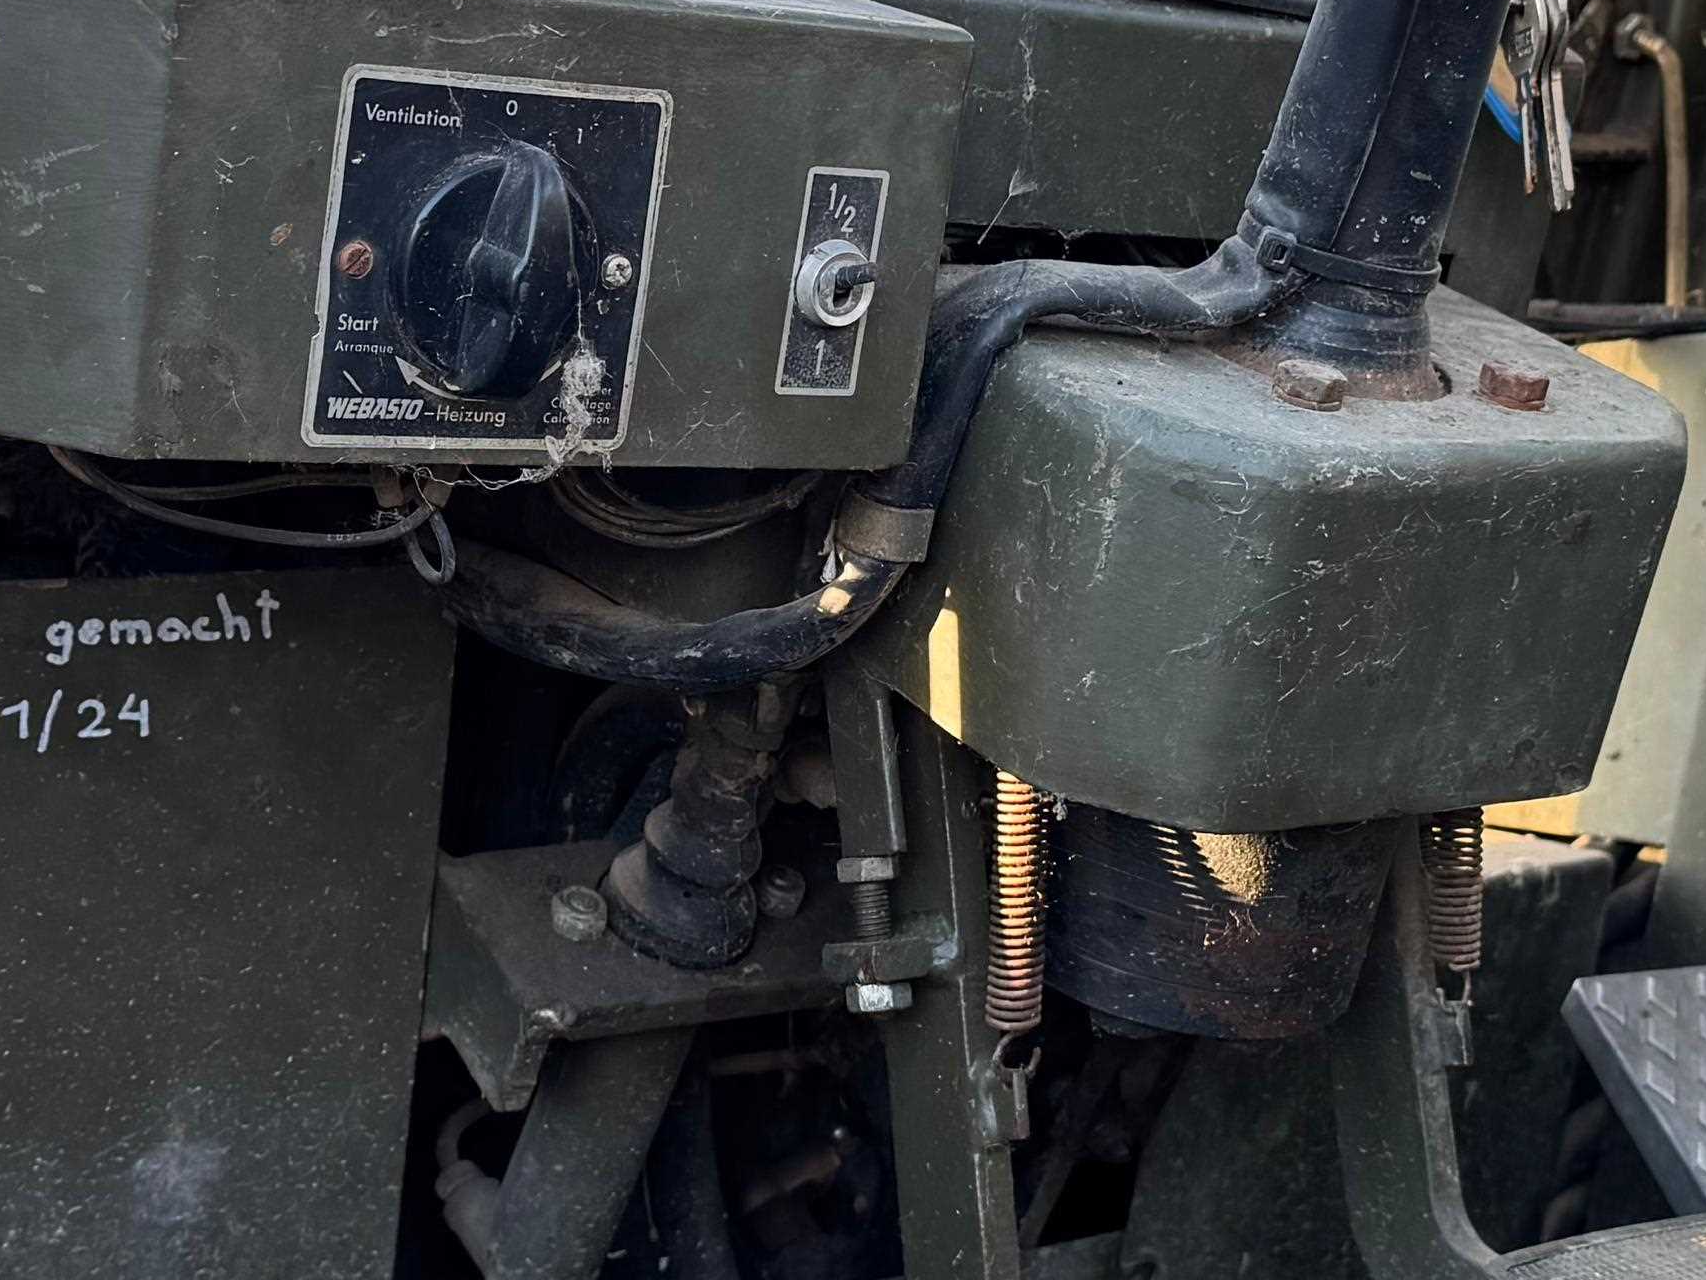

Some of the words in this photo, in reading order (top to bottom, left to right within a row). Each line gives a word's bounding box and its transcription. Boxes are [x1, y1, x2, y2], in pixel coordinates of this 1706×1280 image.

[365, 102, 462, 128] Ventilation
[577, 127, 585, 145] 1
[828, 182, 857, 233] 1/2
[336, 313, 380, 333] Start
[334, 339, 395, 355] Arranque
[814, 339, 826, 376] 1
[44, 588, 281, 666] gemacht
